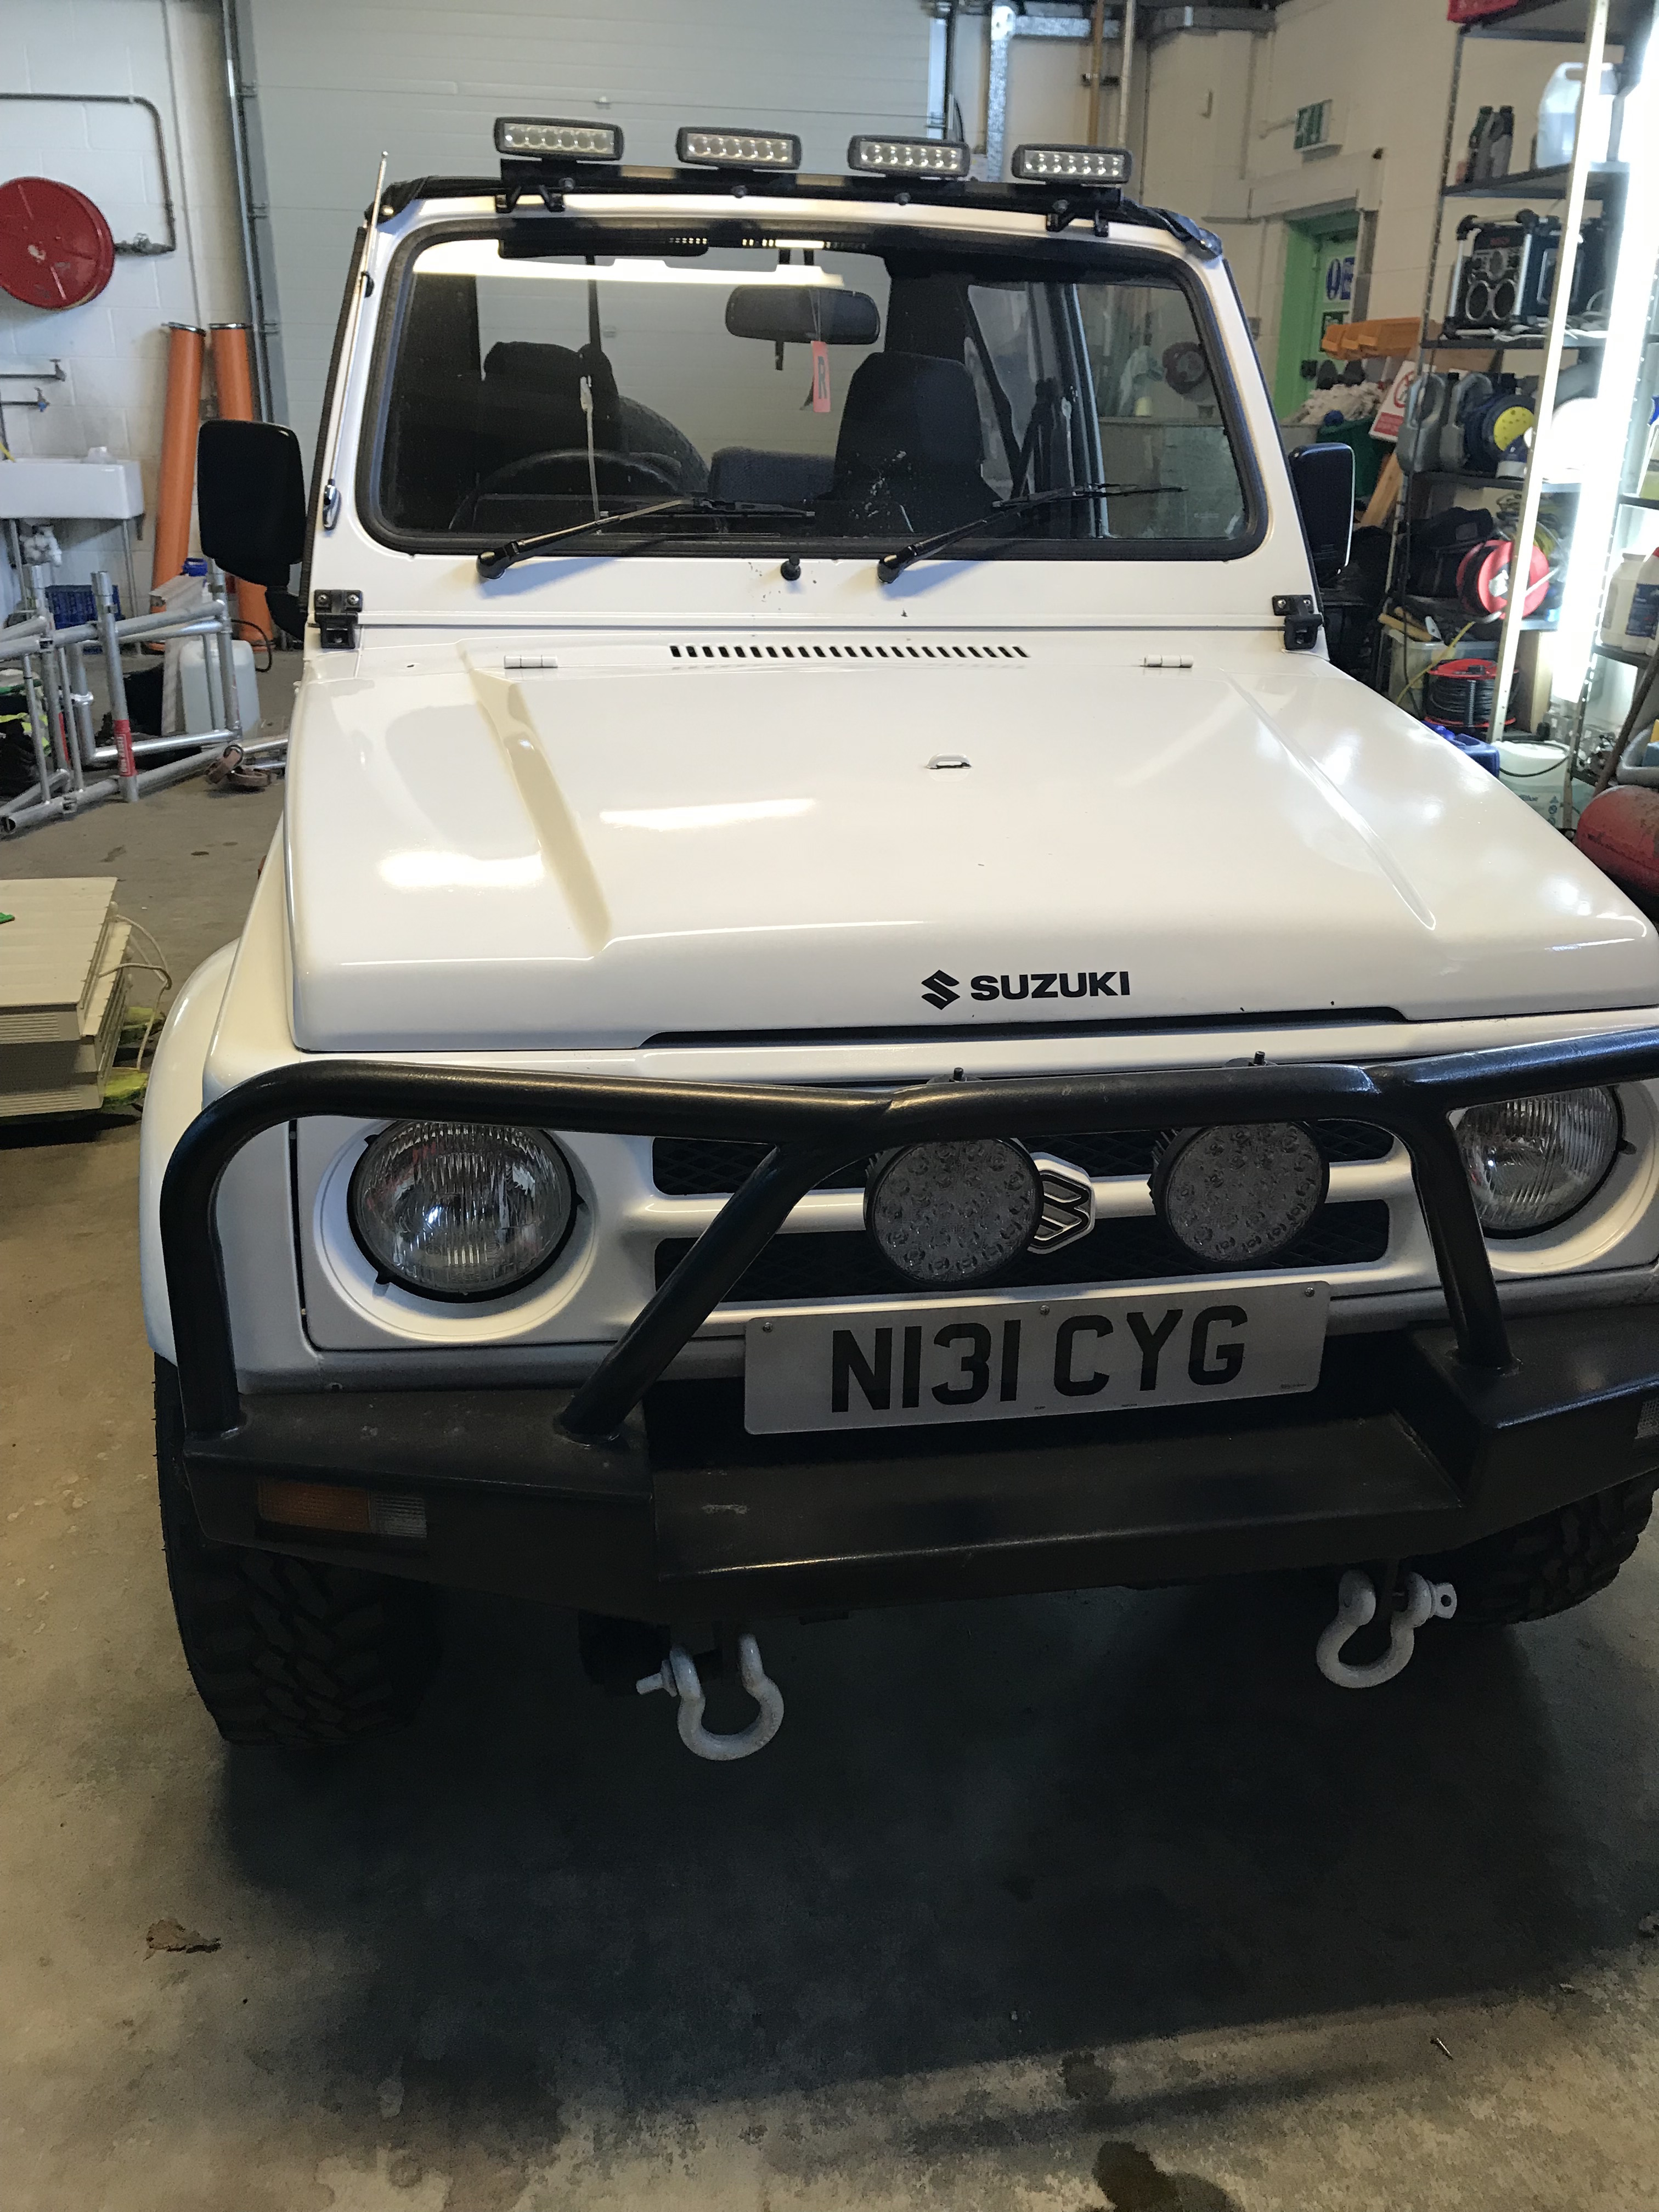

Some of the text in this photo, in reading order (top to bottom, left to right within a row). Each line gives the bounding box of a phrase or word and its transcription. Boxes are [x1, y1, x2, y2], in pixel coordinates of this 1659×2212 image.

[970, 971, 1130, 1001] SUZUKI
[832, 1305, 1249, 1413] N131 CYG
